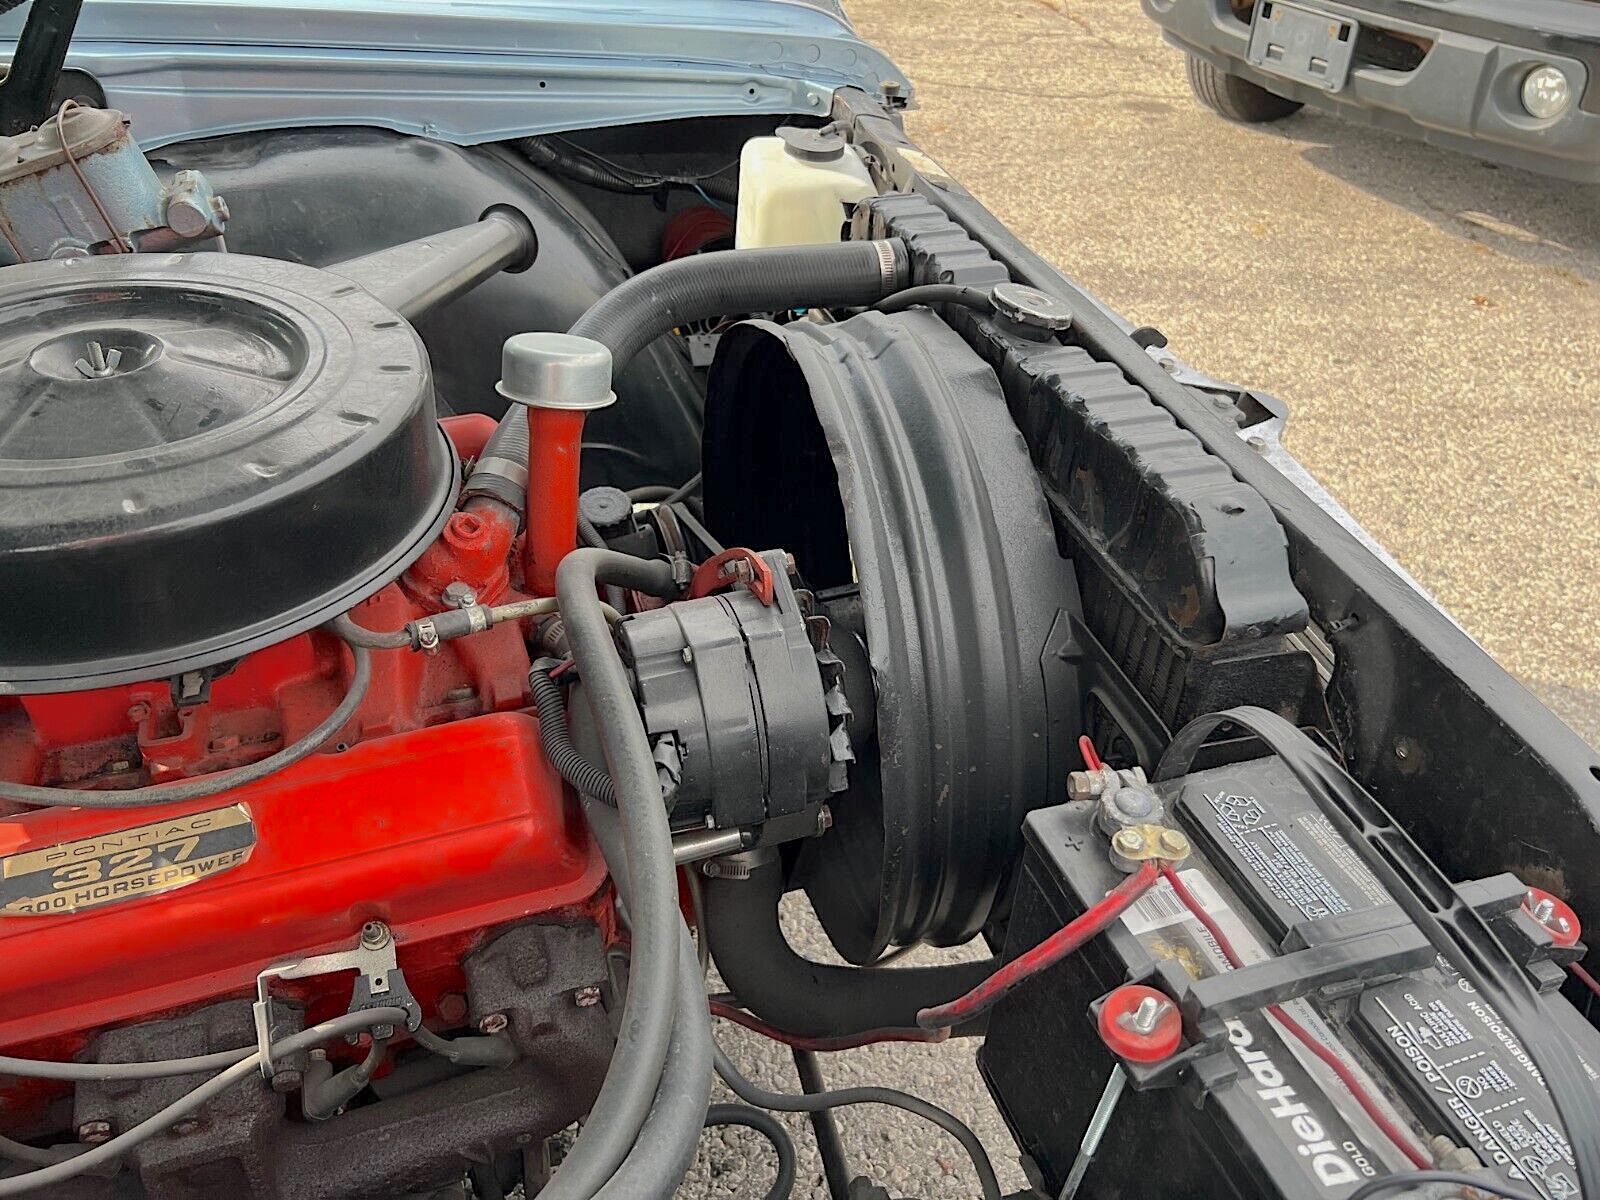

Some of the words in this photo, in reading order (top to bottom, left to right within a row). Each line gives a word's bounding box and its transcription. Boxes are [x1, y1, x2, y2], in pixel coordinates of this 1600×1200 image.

[45, 817, 212, 863] PONTIAC
[52, 835, 200, 890] 327
[1402, 993, 1422, 1010] ACID
[1418, 1010, 1454, 1047] SULFURIC
[1385, 1024, 1442, 1081] POISON
[1222, 1014, 1360, 1188] DieHard
[1475, 1074, 1491, 1090] NO
[1446, 1095, 1510, 1164] DANGER
[1490, 1118, 1522, 1151] SHIELD
[1505, 1124, 1529, 1148] EYES
[1341, 1139, 1376, 1177] GOLD
